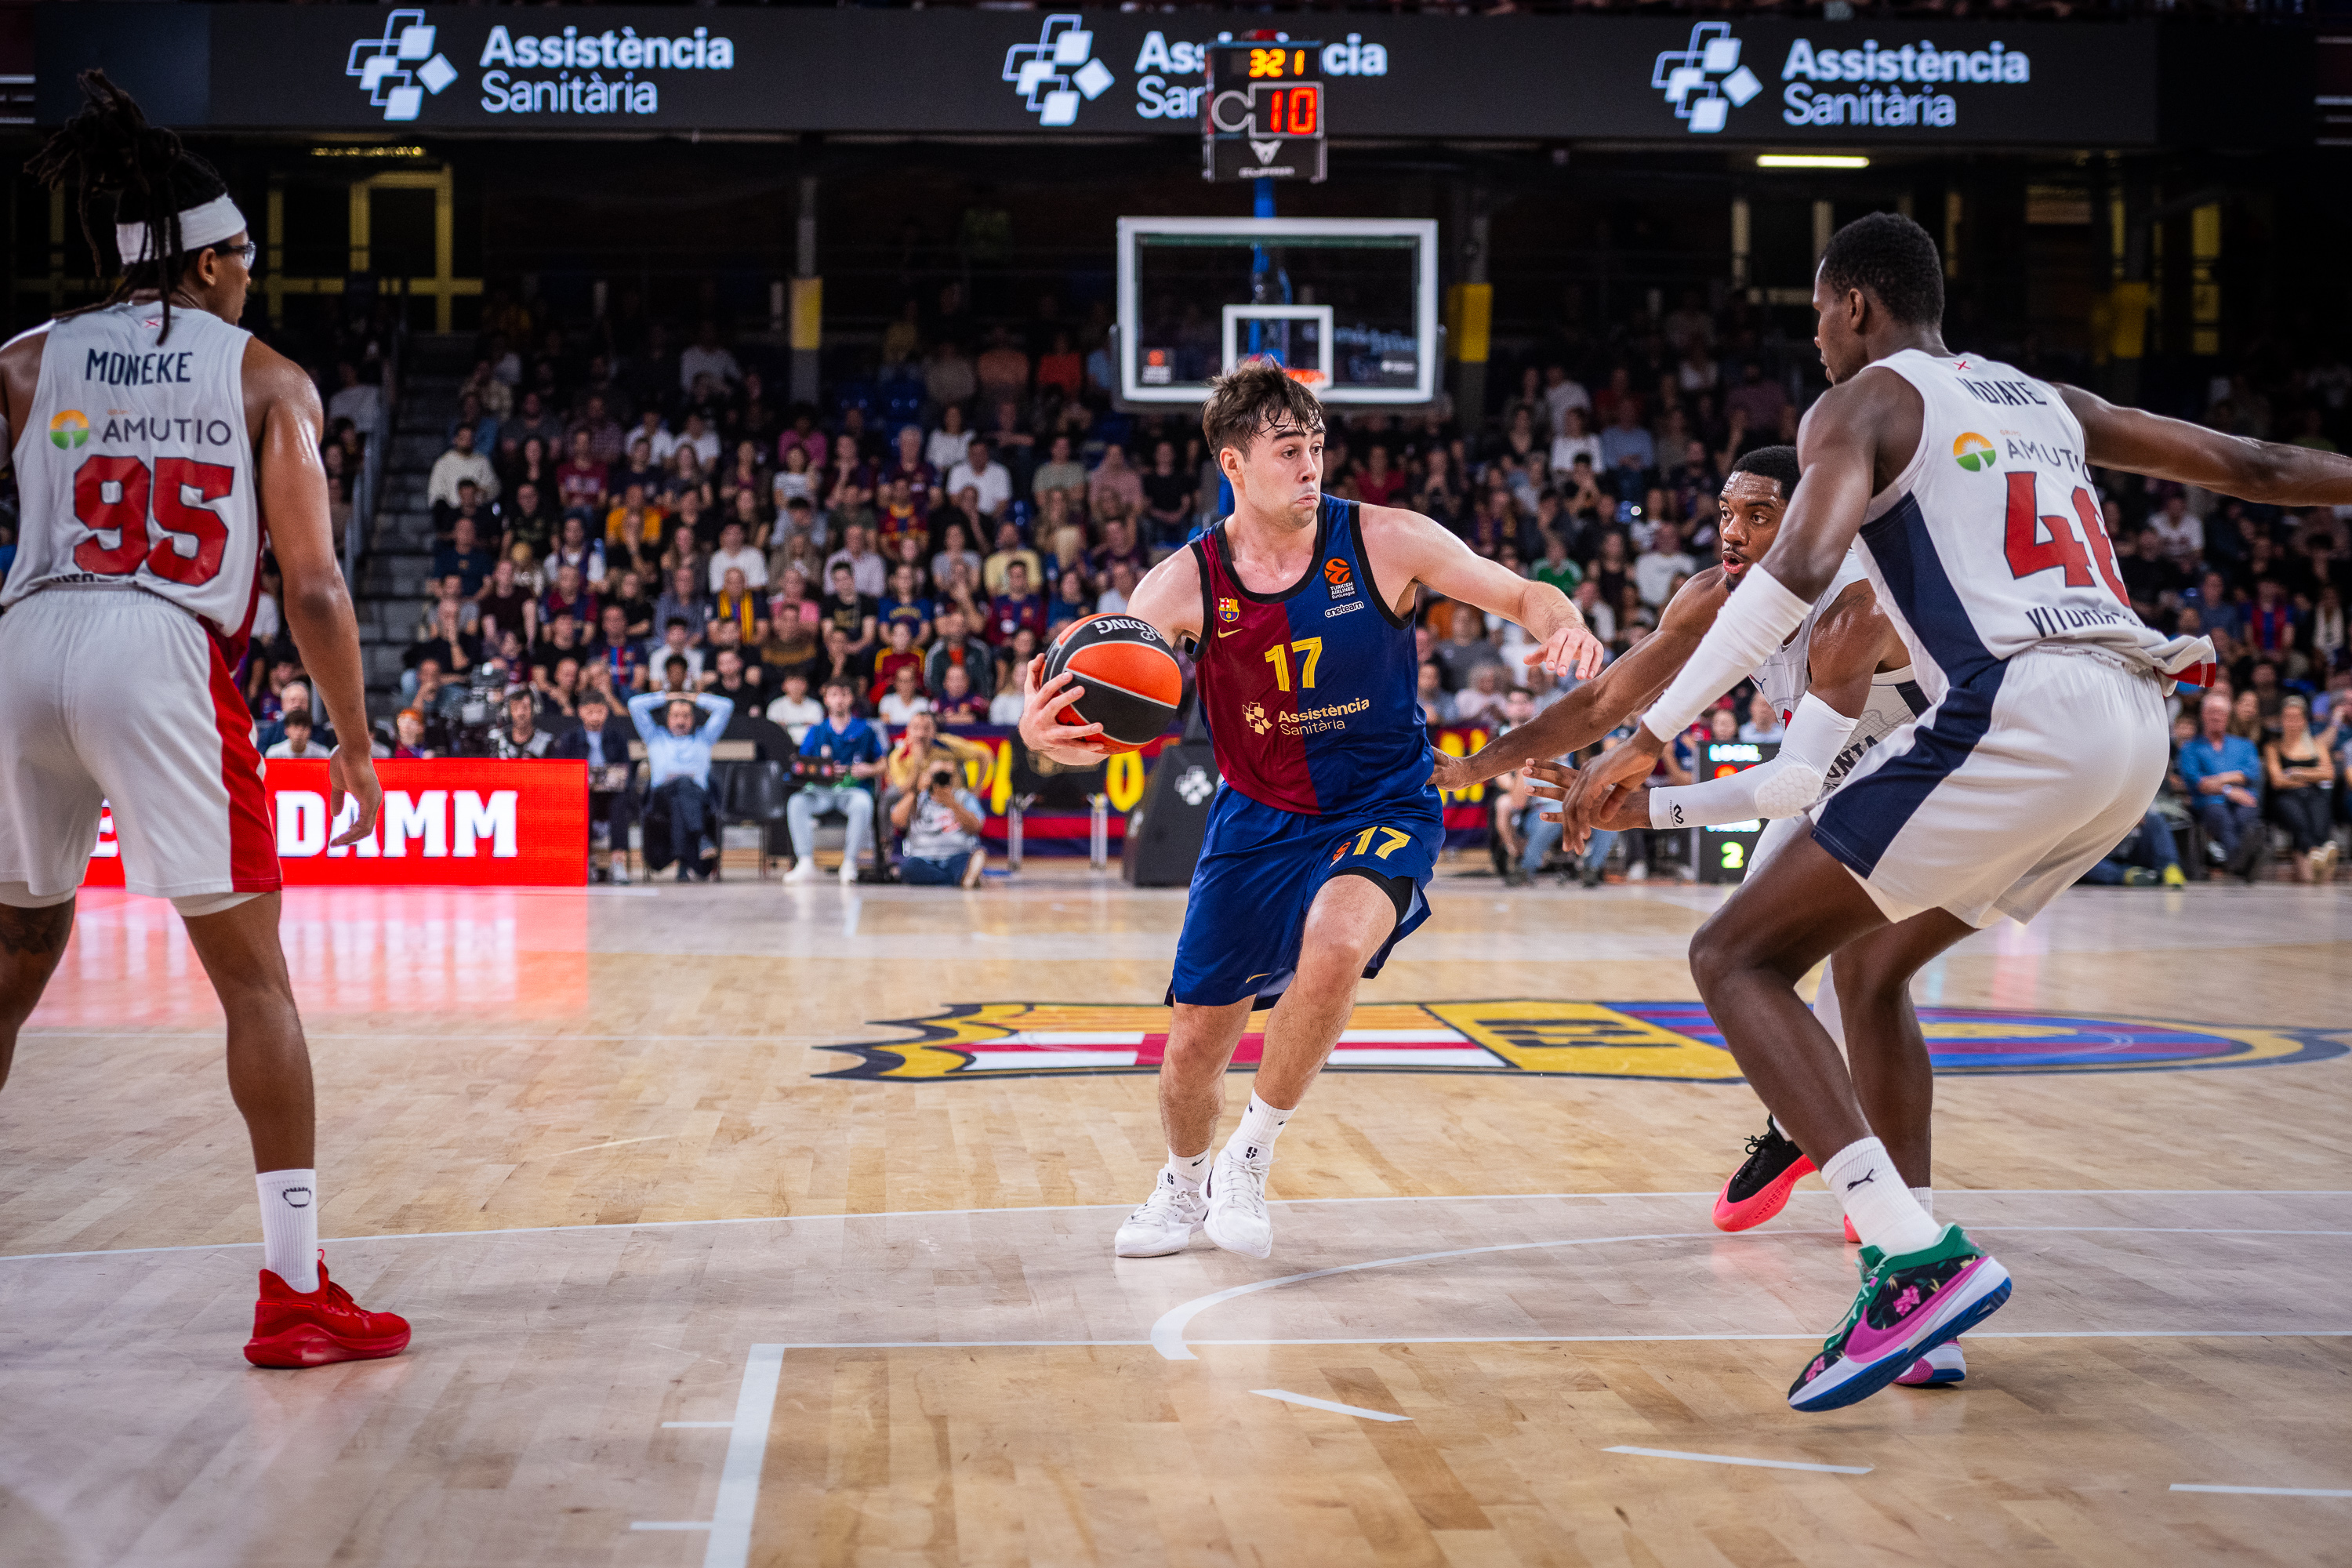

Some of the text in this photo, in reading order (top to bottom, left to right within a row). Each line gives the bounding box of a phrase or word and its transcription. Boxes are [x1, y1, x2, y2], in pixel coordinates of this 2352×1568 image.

[479, 24, 735, 68] Assistència
[1781, 38, 2030, 83] Assistència
[481, 70, 657, 114] Sanitària
[1270, 87, 1317, 135] 10
[1783, 82, 1956, 127] Sanitària
[85, 347, 194, 387] MONEKE
[1955, 376, 2048, 406] NDIAYE
[101, 416, 232, 446] AMUTIO
[73, 454, 235, 587] 95
[1330, 581, 1354, 592] TURKISH
[1331, 586, 1356, 597] AIRLINES
[1325, 601, 1364, 618] oneteam
[1264, 636, 1323, 692] 17
[1278, 697, 1370, 724] Assistència
[1280, 719, 1346, 735] Sanitària
[275, 789, 521, 858] DAMM
[1352, 826, 1411, 860] 17
